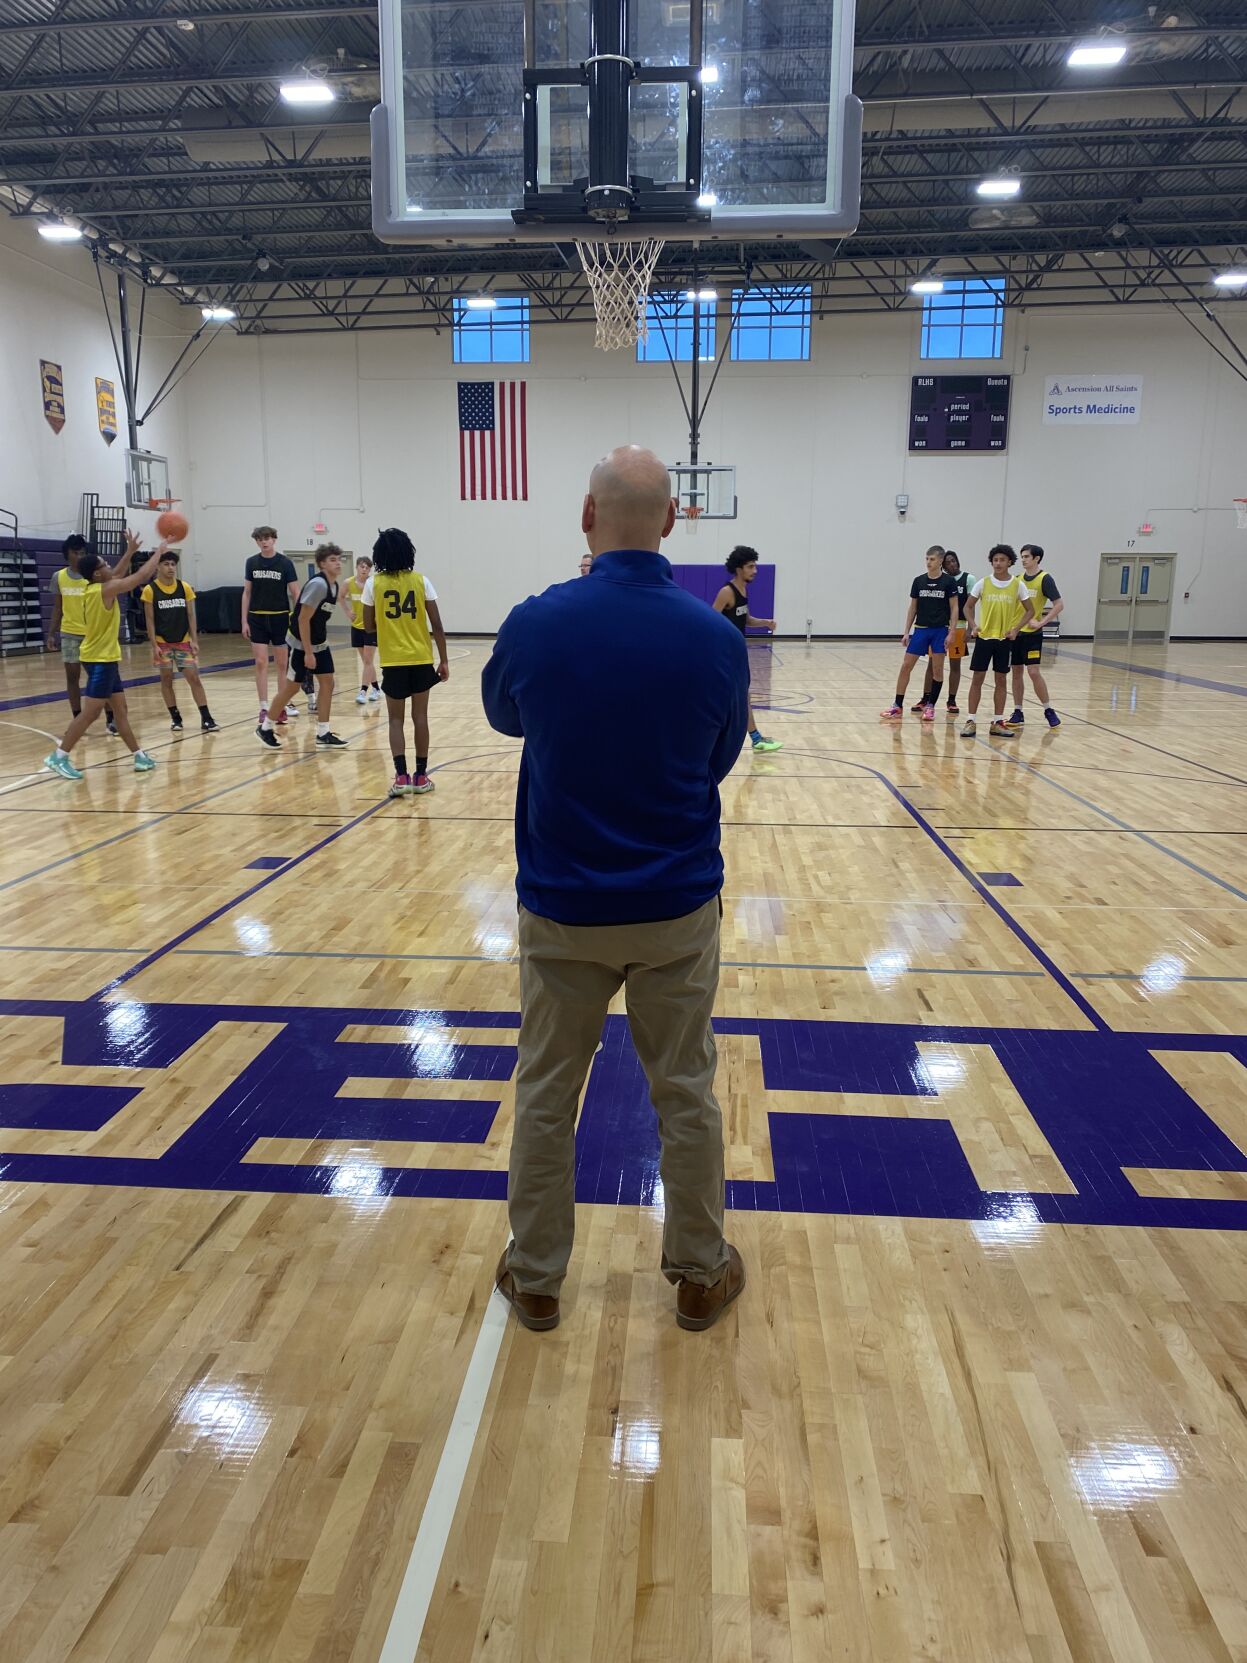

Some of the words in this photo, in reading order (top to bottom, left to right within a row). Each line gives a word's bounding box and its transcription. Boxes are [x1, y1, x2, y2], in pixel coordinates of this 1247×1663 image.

[1065, 385, 1102, 393] Ascension
[1103, 385, 1115, 393] All
[1115, 384, 1138, 392] Saints
[950, 402, 970, 412] period
[1047, 404, 1084, 417] Sports
[1085, 403, 1136, 414] Medicine
[950, 414, 969, 422] player
[1127, 540, 1136, 548] 17
[252, 569, 282, 580] CRUSADERS
[383, 589, 418, 620] 34
